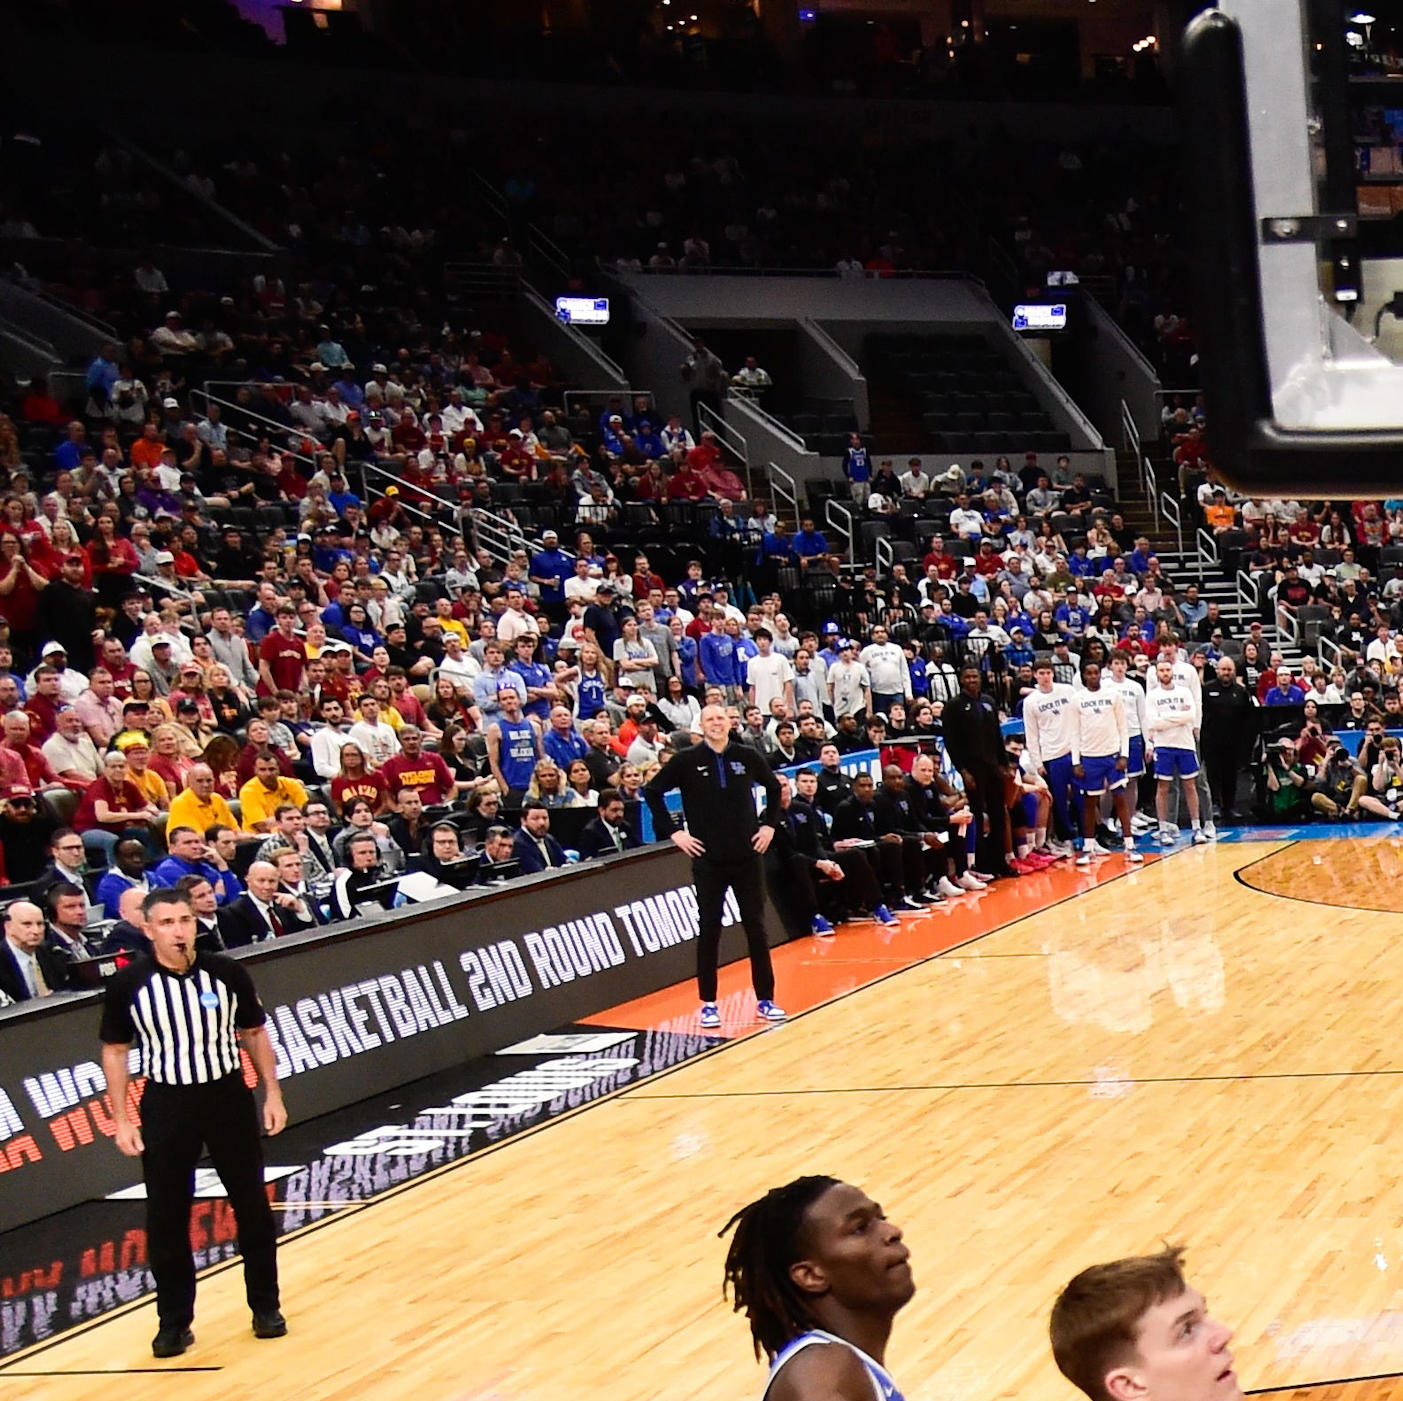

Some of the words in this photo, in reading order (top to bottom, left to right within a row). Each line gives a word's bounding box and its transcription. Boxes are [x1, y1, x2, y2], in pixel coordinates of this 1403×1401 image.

[263, 960, 470, 1081] BASKETBALL
[459, 938, 534, 1012] 2ND
[522, 911, 626, 992] ROUND
[614, 884, 742, 957] TOMOR
[418, 1056, 643, 1116] LOUIS
